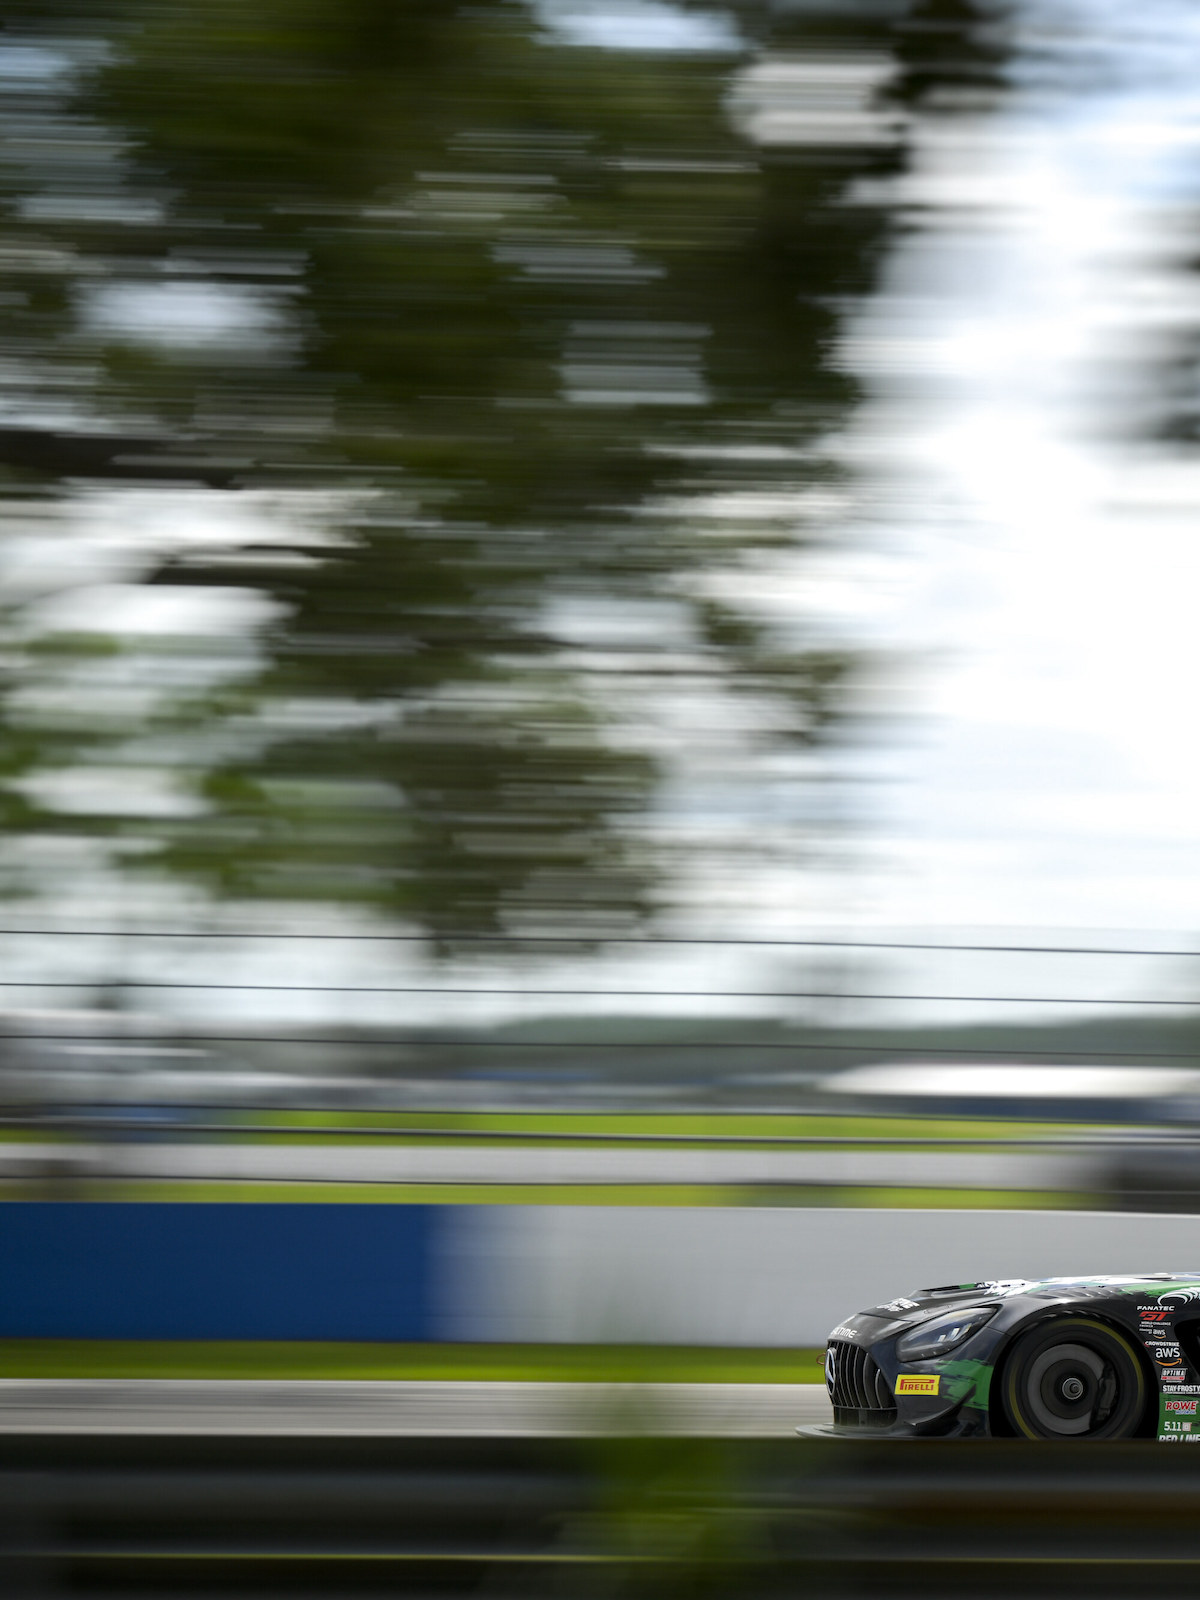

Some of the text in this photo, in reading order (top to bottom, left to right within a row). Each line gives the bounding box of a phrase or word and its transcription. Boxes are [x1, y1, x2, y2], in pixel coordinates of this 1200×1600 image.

[1139, 1311, 1176, 1321] GT
[1156, 1348, 1180, 1358] aws
[900, 1379, 935, 1390] PIRELLI
[1166, 1401, 1198, 1410] ROWE
